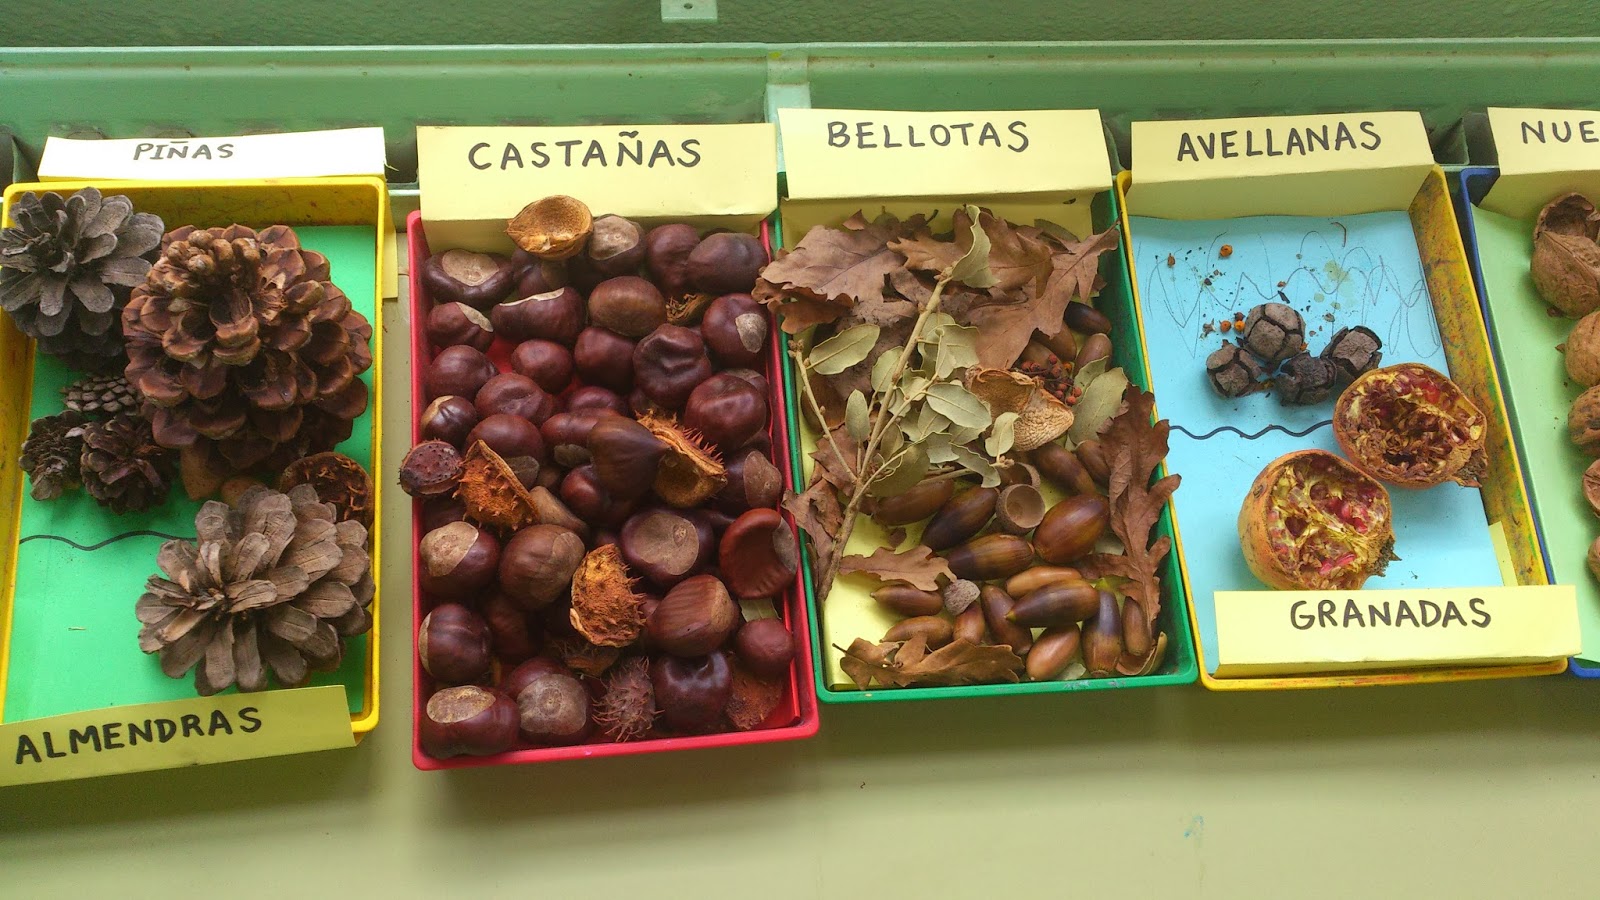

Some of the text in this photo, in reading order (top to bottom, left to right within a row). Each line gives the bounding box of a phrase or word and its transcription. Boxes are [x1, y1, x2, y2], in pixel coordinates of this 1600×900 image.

[827, 120, 1030, 153] BELLOTAS
[1176, 120, 1382, 162] AVELLANAS
[1521, 119, 1600, 145] NUE
[133, 139, 236, 161] PIÑAS
[468, 130, 703, 171] CASTAÑAS
[1289, 597, 1492, 631] GRANADAS
[15, 706, 263, 765] ALMENDRAS
